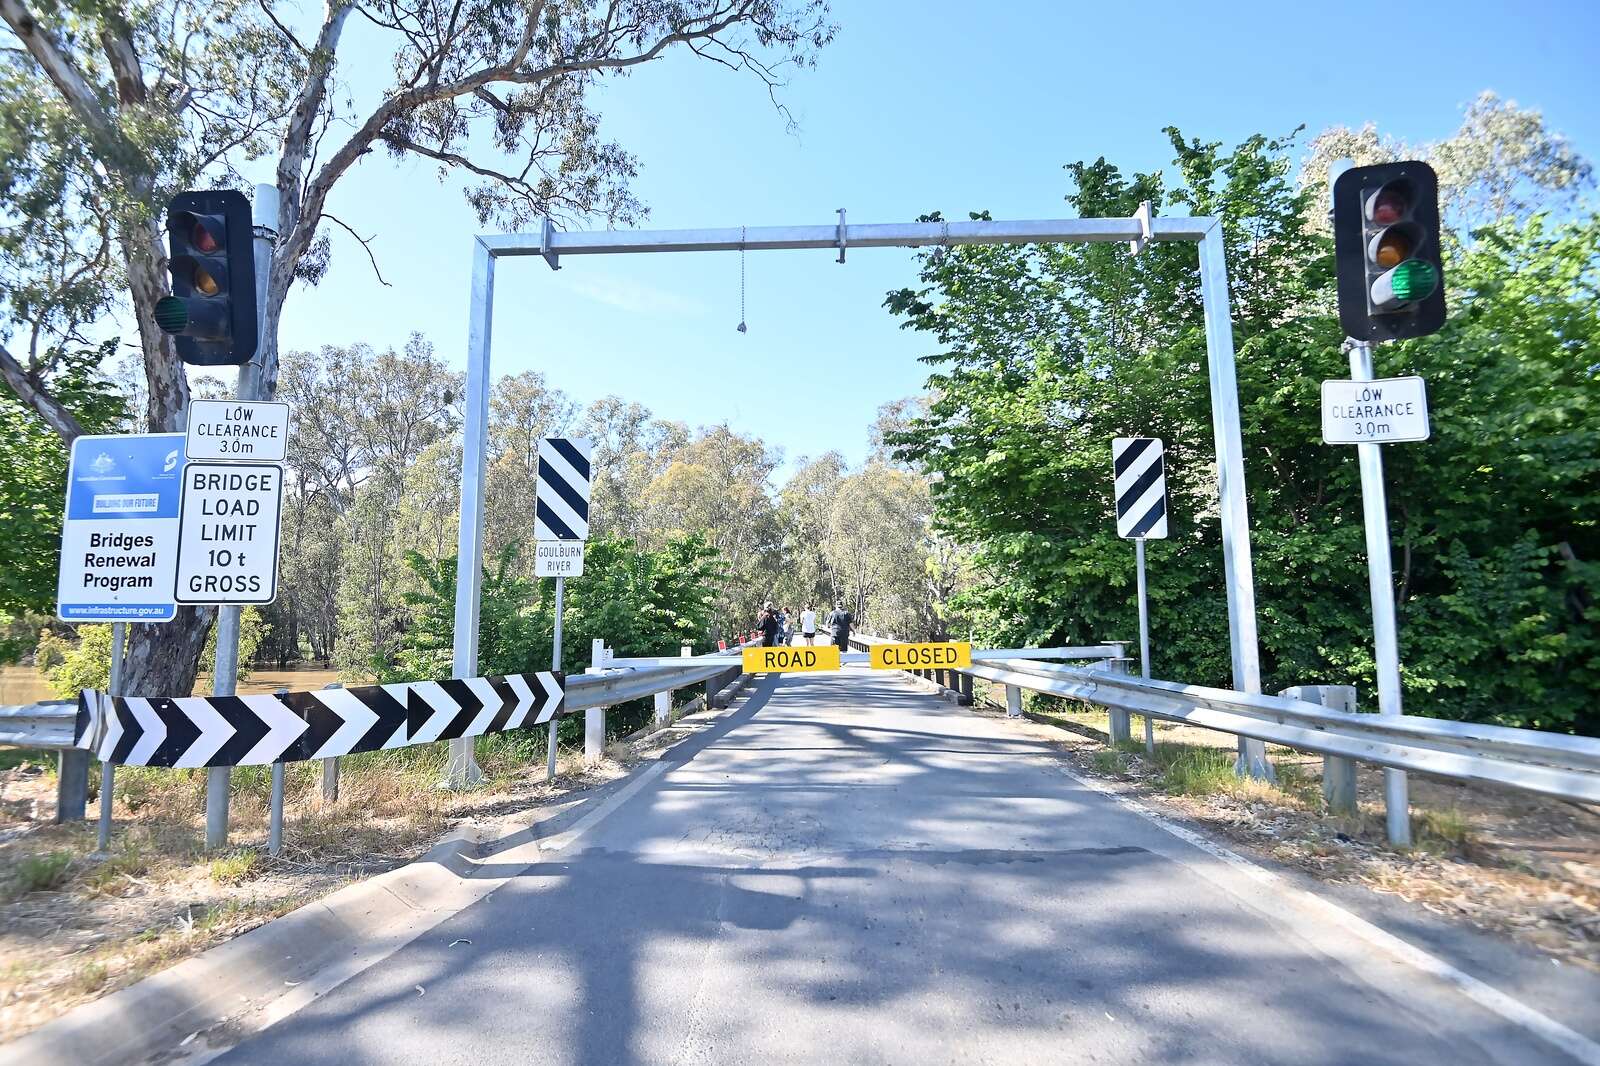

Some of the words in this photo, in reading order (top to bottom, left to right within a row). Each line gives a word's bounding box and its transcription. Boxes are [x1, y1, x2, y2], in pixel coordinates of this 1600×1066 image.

[1355, 388, 1382, 402] LOW
[225, 408, 254, 421] LOW
[1332, 402, 1414, 419] CLEARANCE
[197, 423, 278, 438] CLEARANCE
[1354, 422, 1390, 435] 3.0m
[219, 440, 253, 454] 3.0m
[193, 473, 272, 492] BRIDGE
[201, 499, 260, 517] LOAD
[90, 532, 154, 551] Bridges
[200, 524, 257, 542] LIMIT
[84, 552, 156, 568] Renewal
[208, 550, 232, 567] 10
[237, 552, 246, 567] t
[538, 546, 581, 558] GOULBURN
[547, 560, 571, 572] RIVER
[83, 573, 153, 591] Program
[189, 575, 261, 593] GROSS
[68, 605, 164, 617] www.infrastructure.gov.au
[764, 651, 817, 668] ROAD
[882, 647, 958, 666] CLOSED
